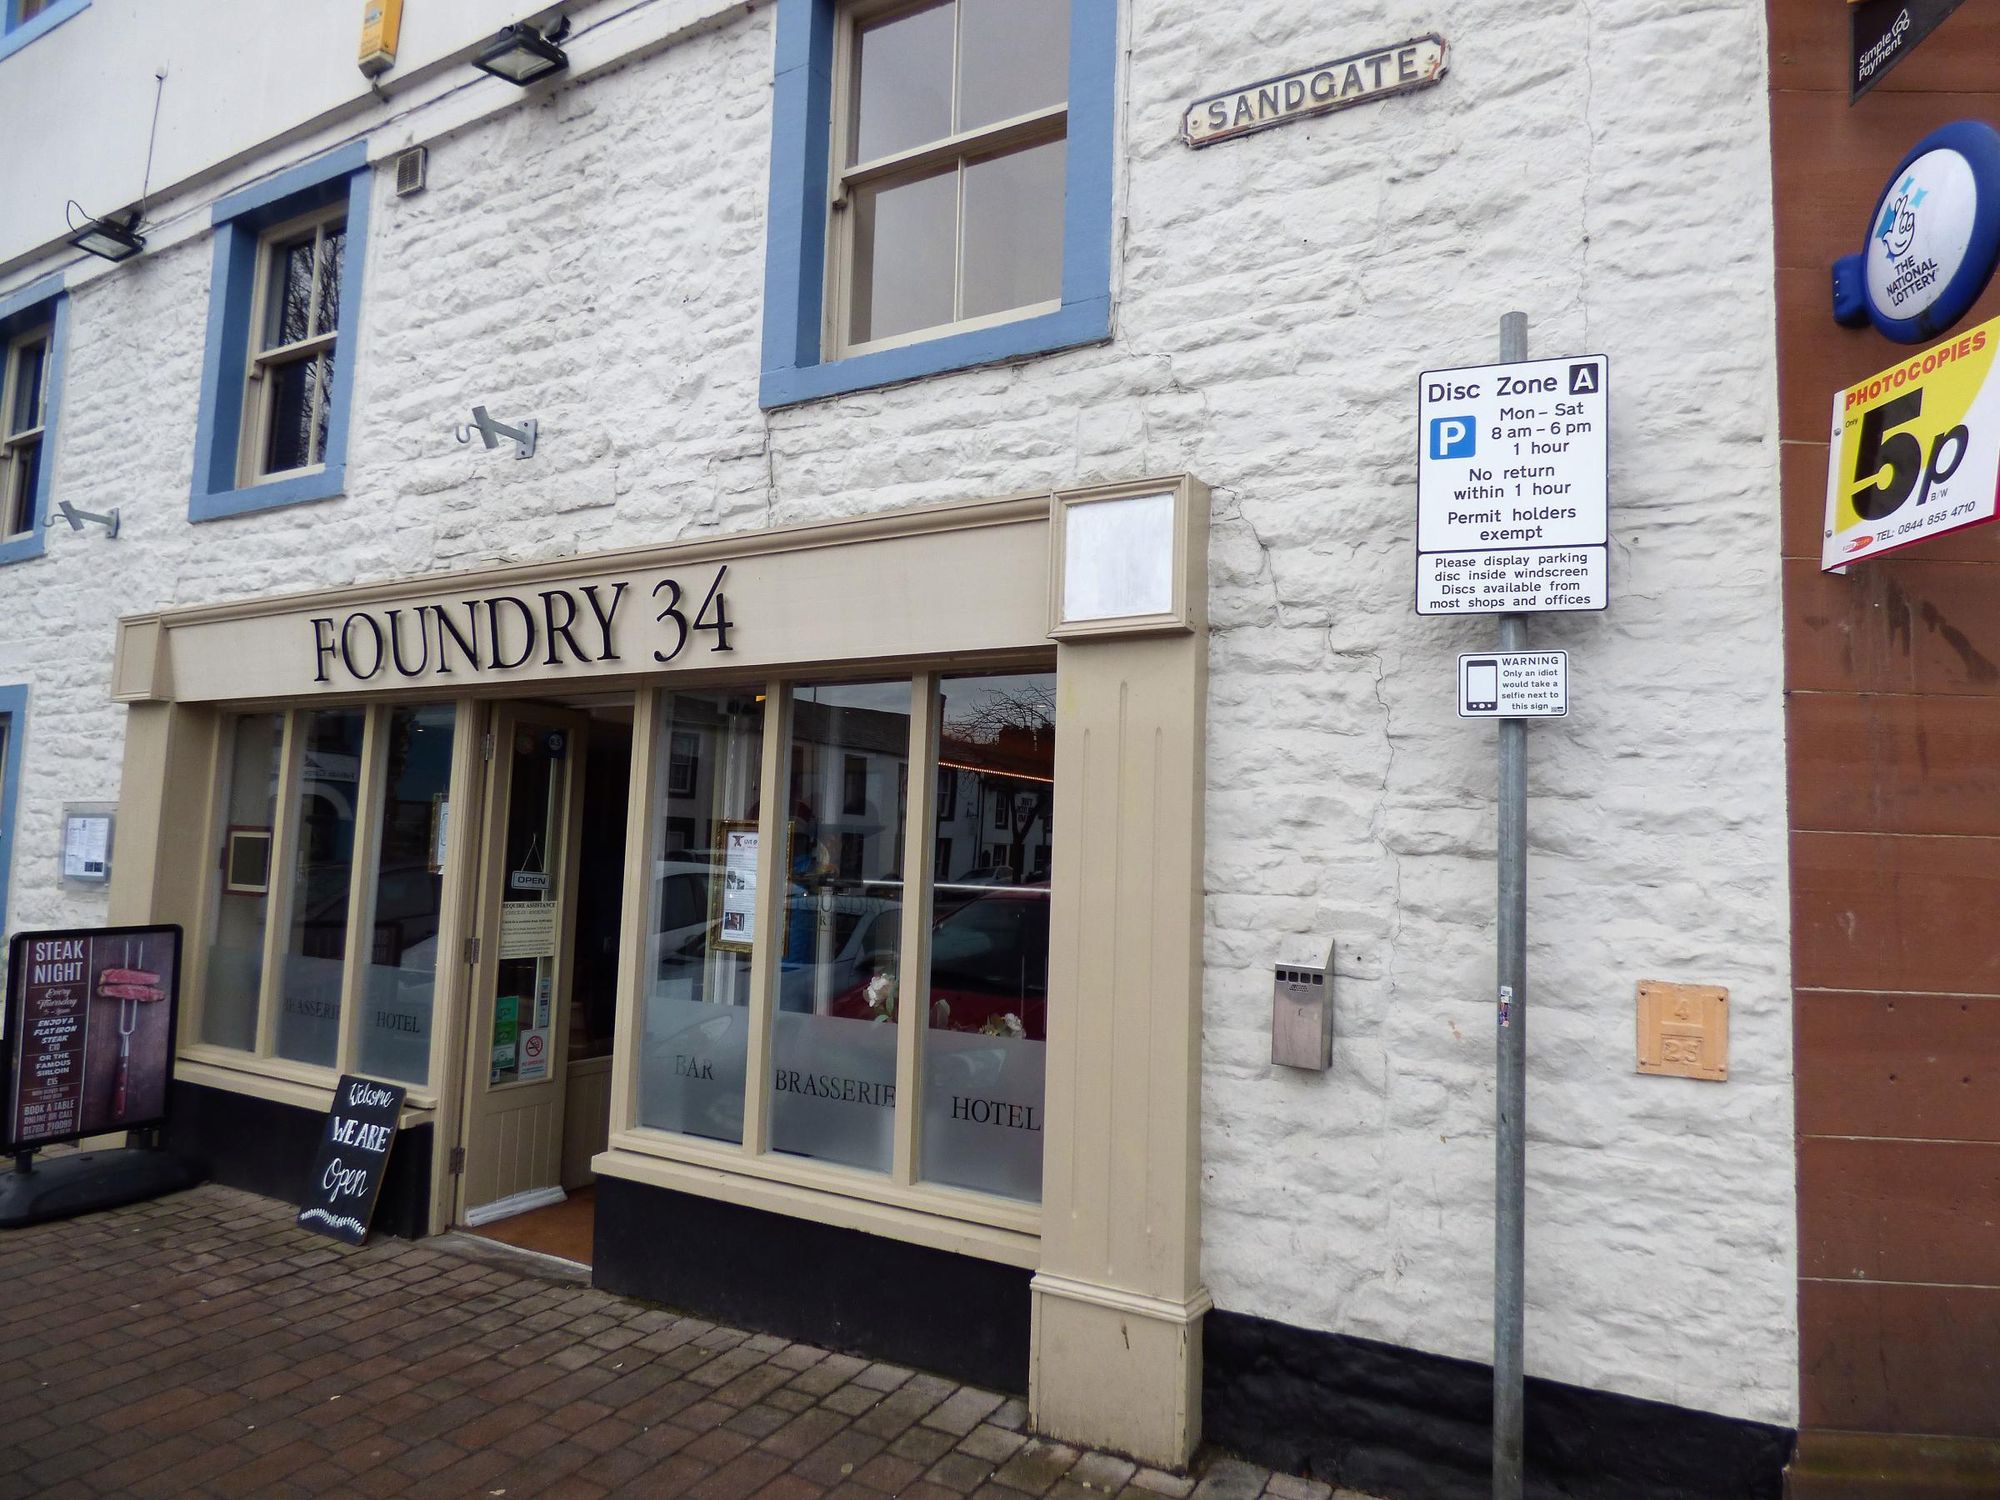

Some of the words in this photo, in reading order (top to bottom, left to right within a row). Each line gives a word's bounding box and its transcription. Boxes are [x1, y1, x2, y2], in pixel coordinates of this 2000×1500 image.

[1858, 34, 1903, 82] Payment
[1859, 32, 1892, 69] Simple
[1207, 47, 1418, 130] SANDGATE
[1894, 255, 1916, 276] THE
[1886, 257, 1938, 297] NATIONAL
[1891, 269, 1937, 307] LOTTERY
[1845, 330, 1987, 411] PHOTOCOPIES
[1428, 382, 1481, 403] Disc
[1496, 376, 1558, 397] Zone
[1572, 367, 1595, 391] A
[1500, 407, 1535, 422] Mon
[1554, 401, 1584, 417] Sat
[1491, 426, 1502, 440] 8
[1507, 425, 1532, 439] am
[1550, 421, 1561, 435] 6
[1566, 421, 1592, 436] pm
[1845, 417, 1859, 428] Only
[1439, 420, 1466, 456] P
[1513, 442, 1520, 455] 1
[1531, 441, 1570, 455] hour
[1850, 386, 1969, 521] 5p
[1469, 468, 1493, 482] No
[1503, 465, 1555, 480] return
[1453, 484, 1505, 500] within
[1515, 483, 1521, 497] 1
[1532, 482, 1571, 496] hour
[1448, 508, 1501, 525] Permit
[1512, 506, 1577, 521] holders
[1876, 529, 1895, 542] TEL:
[1897, 518, 1924, 534] 0844
[1926, 510, 1948, 525] 855
[1950, 500, 1976, 517] 4710
[1480, 525, 1543, 541] exempt
[1435, 557, 1476, 568] Please
[1483, 556, 1530, 567] display
[1538, 552, 1588, 565] parking
[1434, 571, 1461, 582] disc
[1468, 569, 1507, 580] inside
[1514, 567, 1589, 579] windscreen
[1441, 584, 1476, 595] Discs
[1483, 582, 1542, 594] available
[1549, 581, 1580, 591] from
[1430, 598, 1460, 609] most
[1468, 597, 1505, 609] shops
[1512, 595, 1537, 607] and
[1544, 594, 1591, 605] offices
[310, 581, 629, 682] FOUNDRY
[652, 564, 734, 663] 34
[1501, 656, 1559, 666] WARNING
[1502, 670, 1522, 678] Only
[1538, 669, 1558, 677] idiot
[1502, 681, 1529, 689] would
[1531, 680, 1551, 688] take
[1549, 691, 1559, 699] to
[1530, 703, 1549, 711] sign
[517, 876, 546, 885] OPEN
[36, 940, 84, 962] STEAK
[34, 962, 84, 984] NIGHT
[37, 999, 78, 1009] Thursday
[1673, 999, 1688, 1020] 4
[33, 1028, 55, 1036] FLAT
[55, 1025, 78, 1034] IRON
[38, 1018, 68, 1027] ENJOY
[376, 1011, 420, 1033] HOTEL
[41, 1035, 69, 1044] STEAK
[1663, 1040, 1699, 1062] 25
[36, 1060, 72, 1070] FAMOUS
[36, 1067, 70, 1077] SIRLOIN
[674, 1054, 715, 1081] BAR
[349, 1082, 394, 1108] Welcome
[775, 1069, 896, 1108] BRASSERIE
[24, 1104, 45, 1116] BOOK
[46, 1103, 52, 1112] A
[54, 1099, 75, 1111] TABLE
[951, 1096, 1042, 1131] HOTEL
[332, 1115, 360, 1145] WE
[353, 1123, 393, 1153] ARE
[323, 1157, 369, 1203] Open
